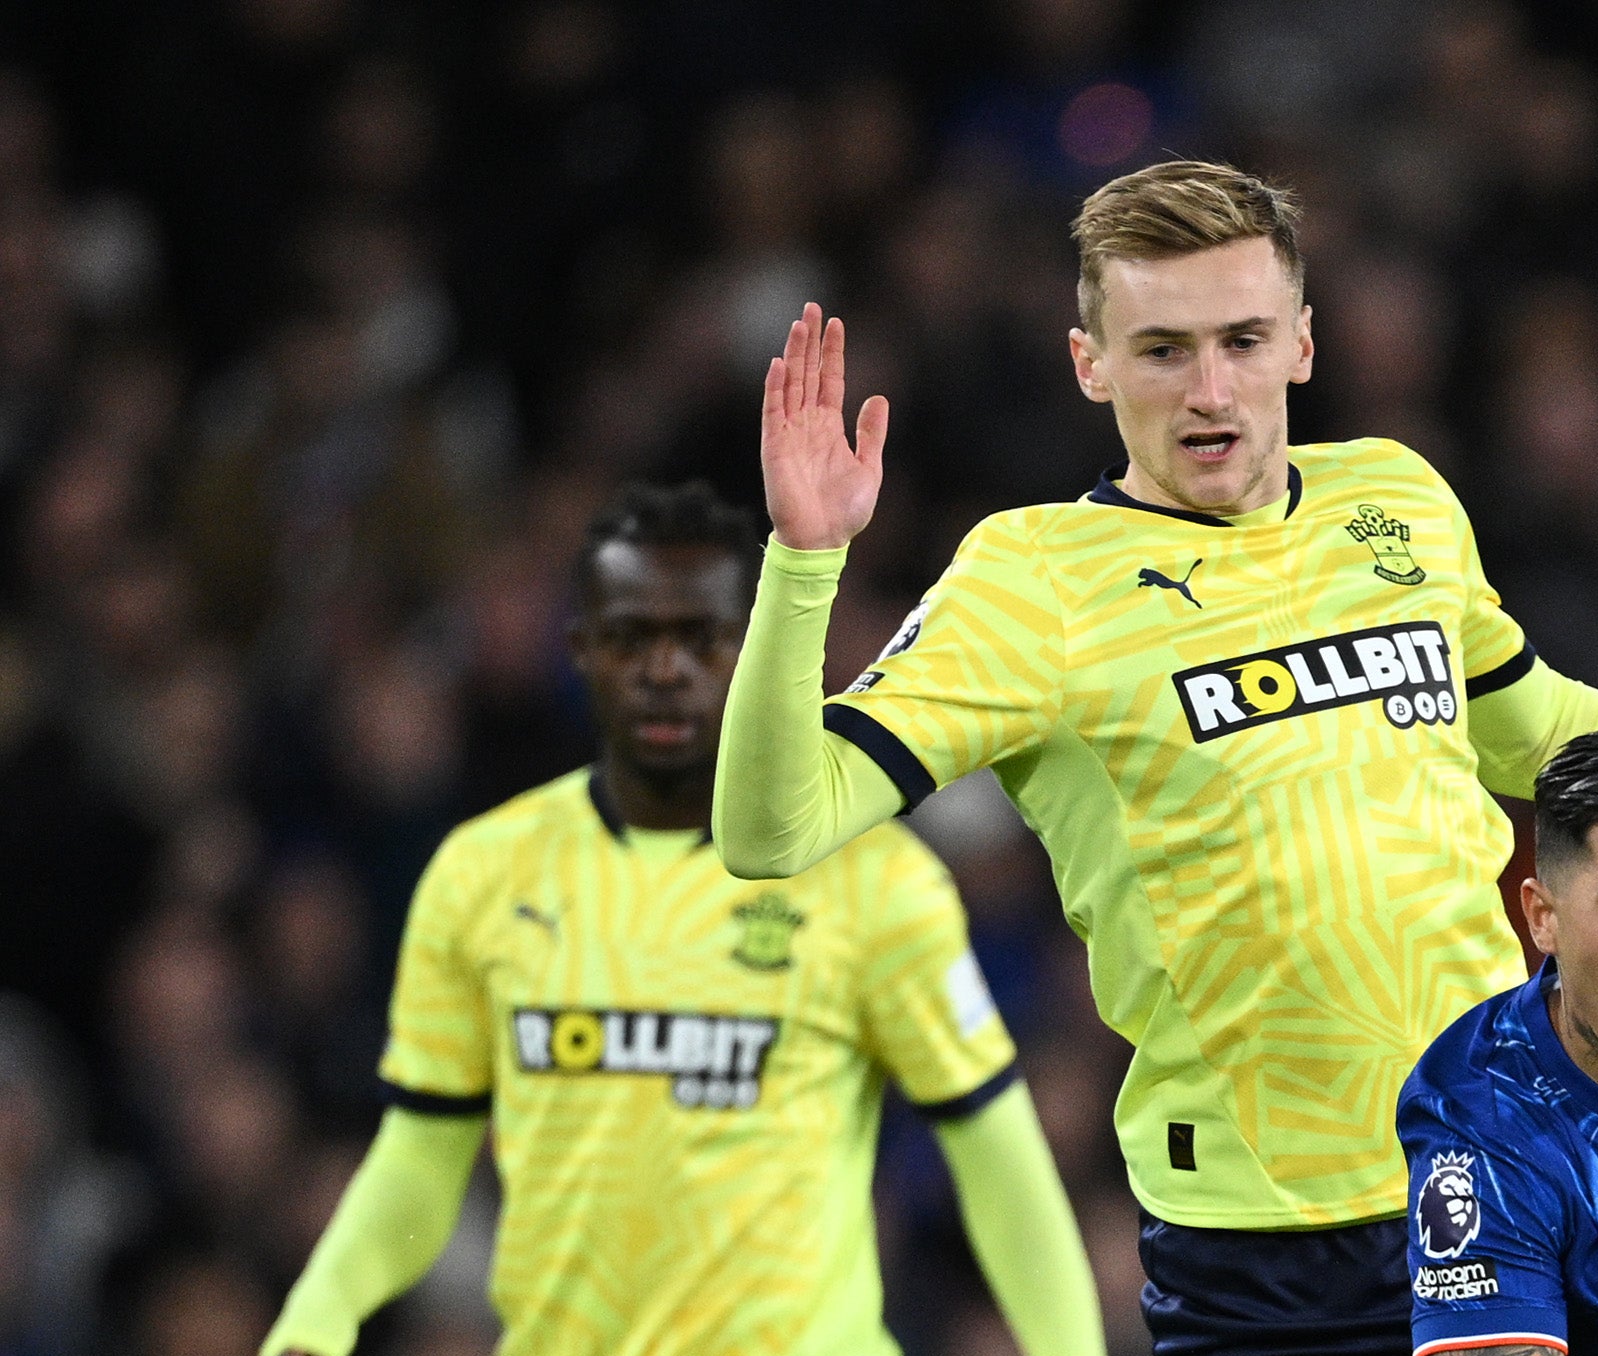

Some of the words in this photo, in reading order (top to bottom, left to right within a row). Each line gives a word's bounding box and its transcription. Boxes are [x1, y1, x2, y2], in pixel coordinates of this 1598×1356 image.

[1183, 629, 1448, 732] ROLLBIT
[1436, 1263, 1486, 1285] room
[1438, 1277, 1500, 1301] racism
